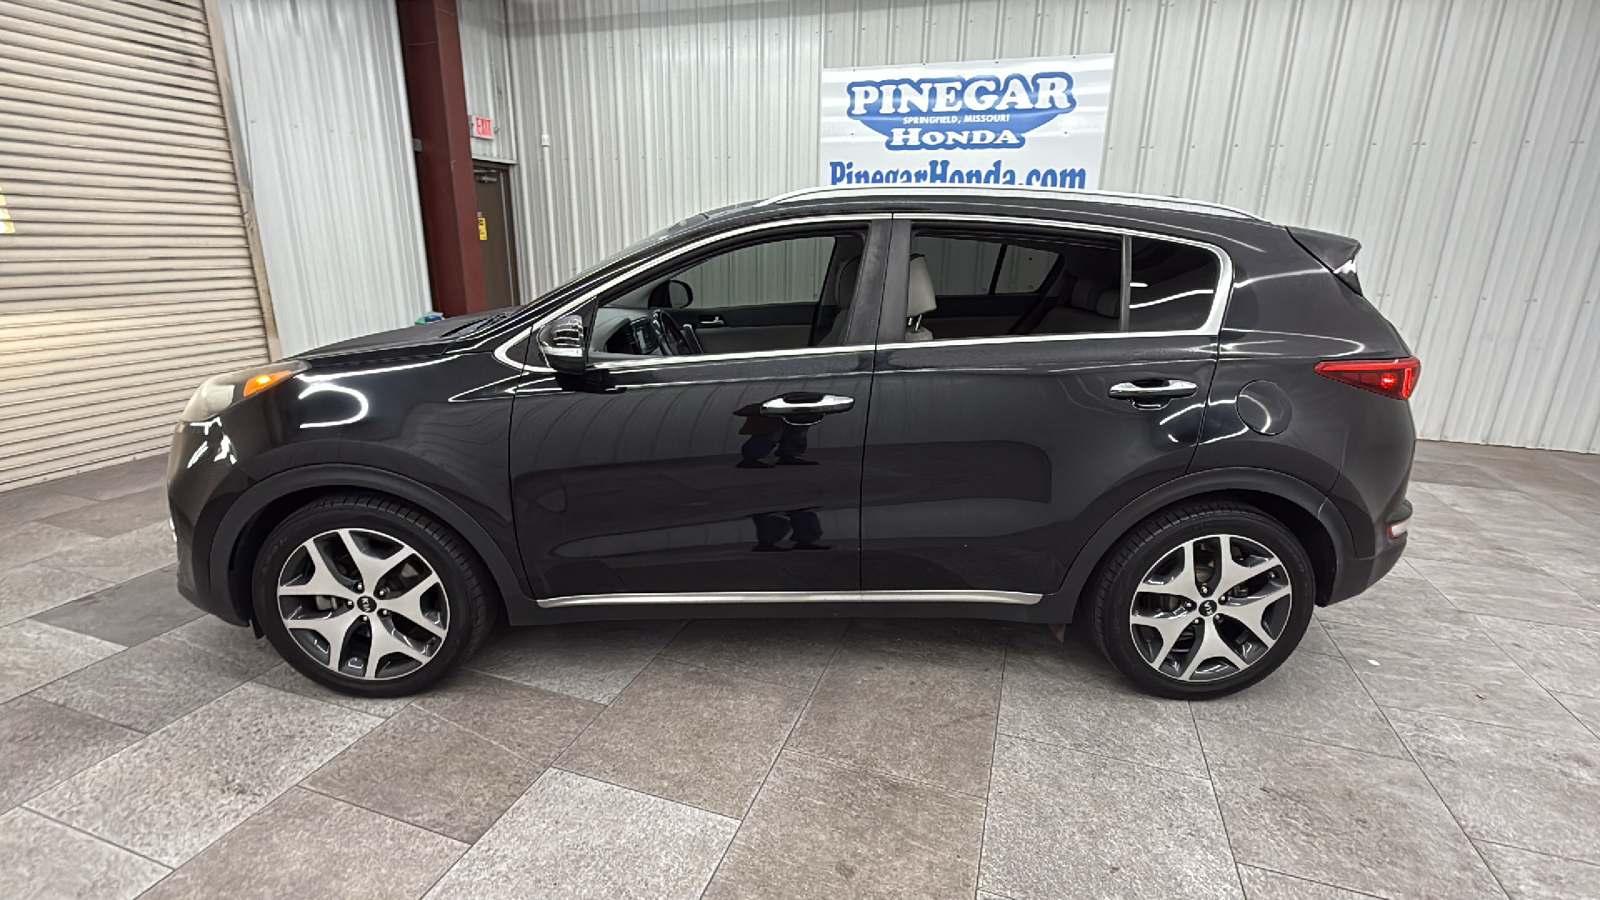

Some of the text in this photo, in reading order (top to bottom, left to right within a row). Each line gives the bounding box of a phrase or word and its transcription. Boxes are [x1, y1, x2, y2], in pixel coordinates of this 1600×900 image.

[851, 77, 1072, 115] PINEGAR
[475, 117, 492, 136] EXIT
[902, 113, 1010, 125] SPRINGFIELD, MISSOURI
[889, 127, 1021, 147] HONDA
[361, 597, 371, 612] KIA
